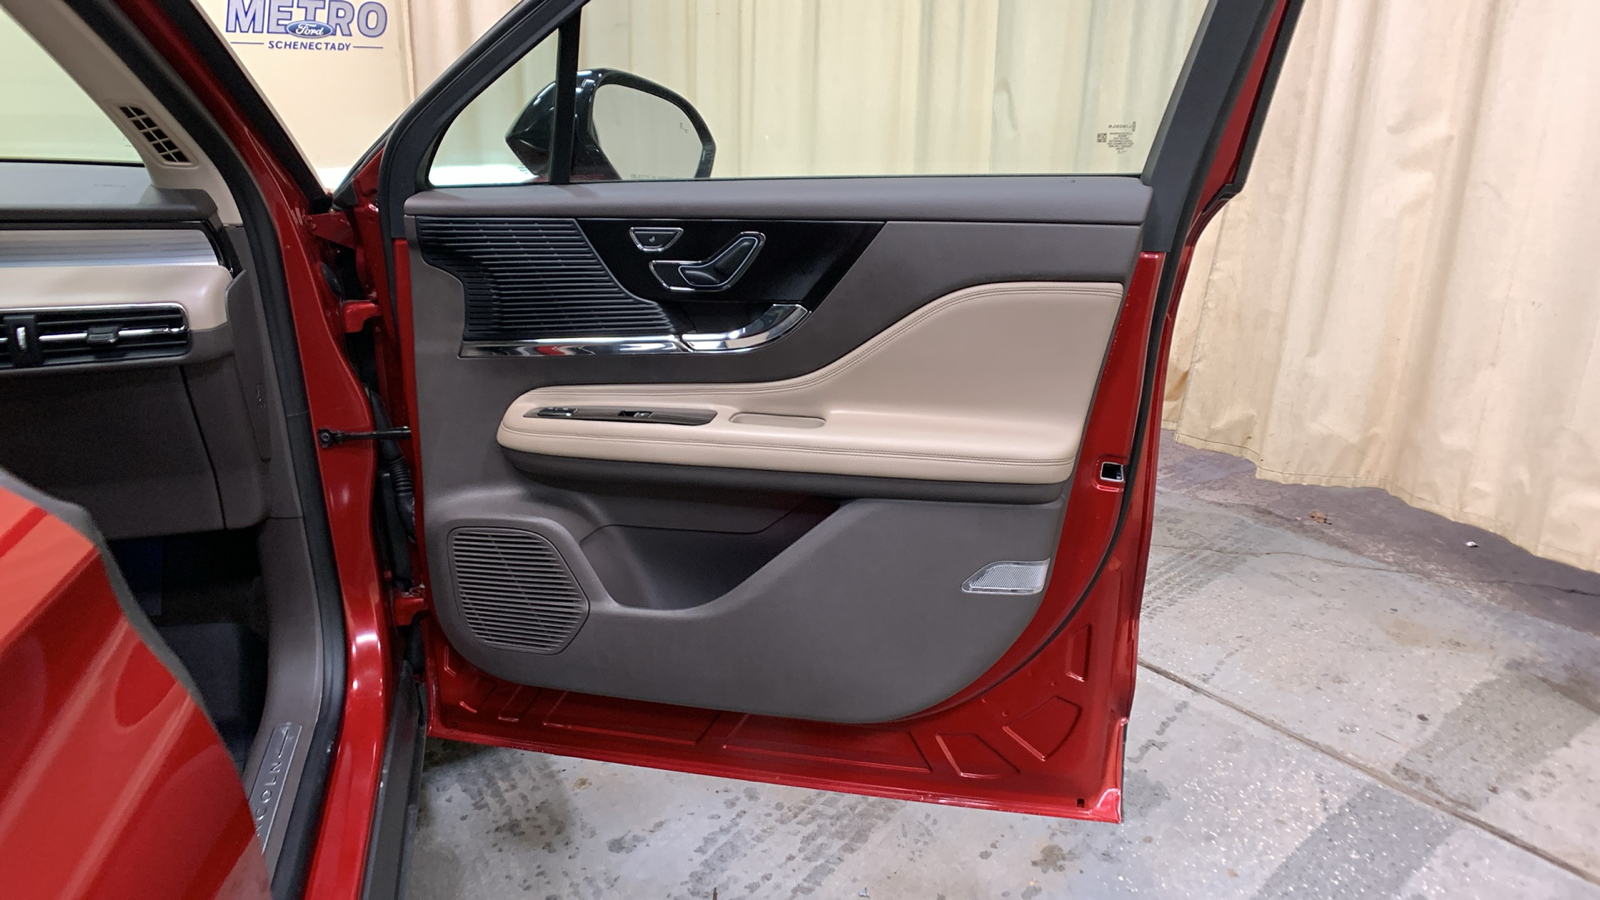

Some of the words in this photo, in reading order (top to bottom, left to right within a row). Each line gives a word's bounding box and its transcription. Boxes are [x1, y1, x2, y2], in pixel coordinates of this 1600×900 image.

[225, 0, 388, 38] METRO
[294, 23, 325, 36] Ford
[268, 40, 351, 51] SCHENECTADY
